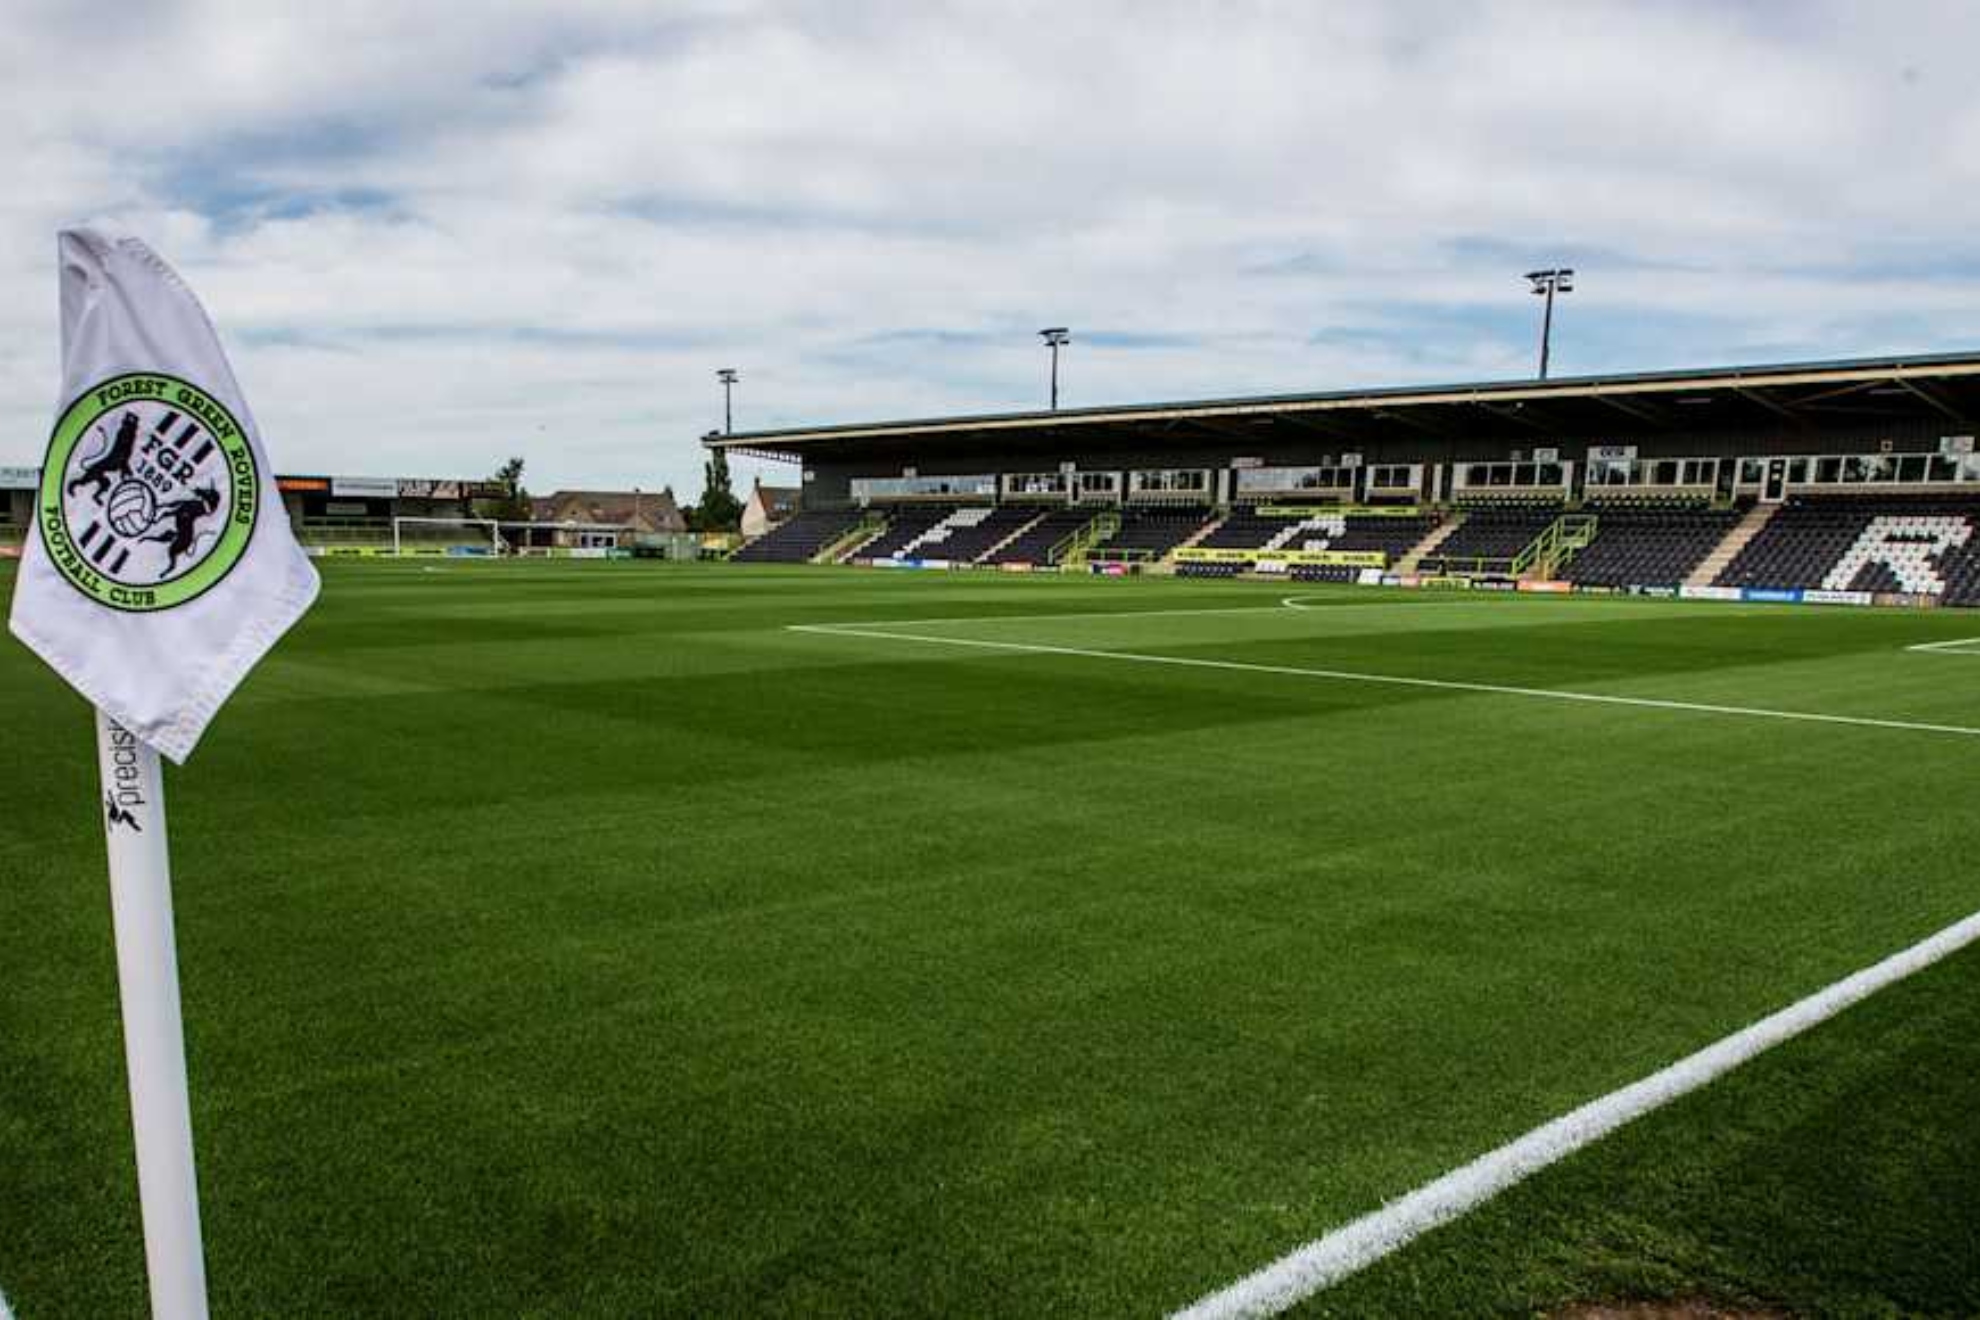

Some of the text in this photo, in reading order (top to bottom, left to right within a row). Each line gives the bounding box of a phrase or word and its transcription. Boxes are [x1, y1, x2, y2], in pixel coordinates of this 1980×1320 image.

[97, 380, 253, 524] FOREST GREEN ROVERS
[141, 433, 194, 485] FGR
[44, 506, 156, 606] FOOTBALL CLUB
[1821, 515, 1974, 595] R
